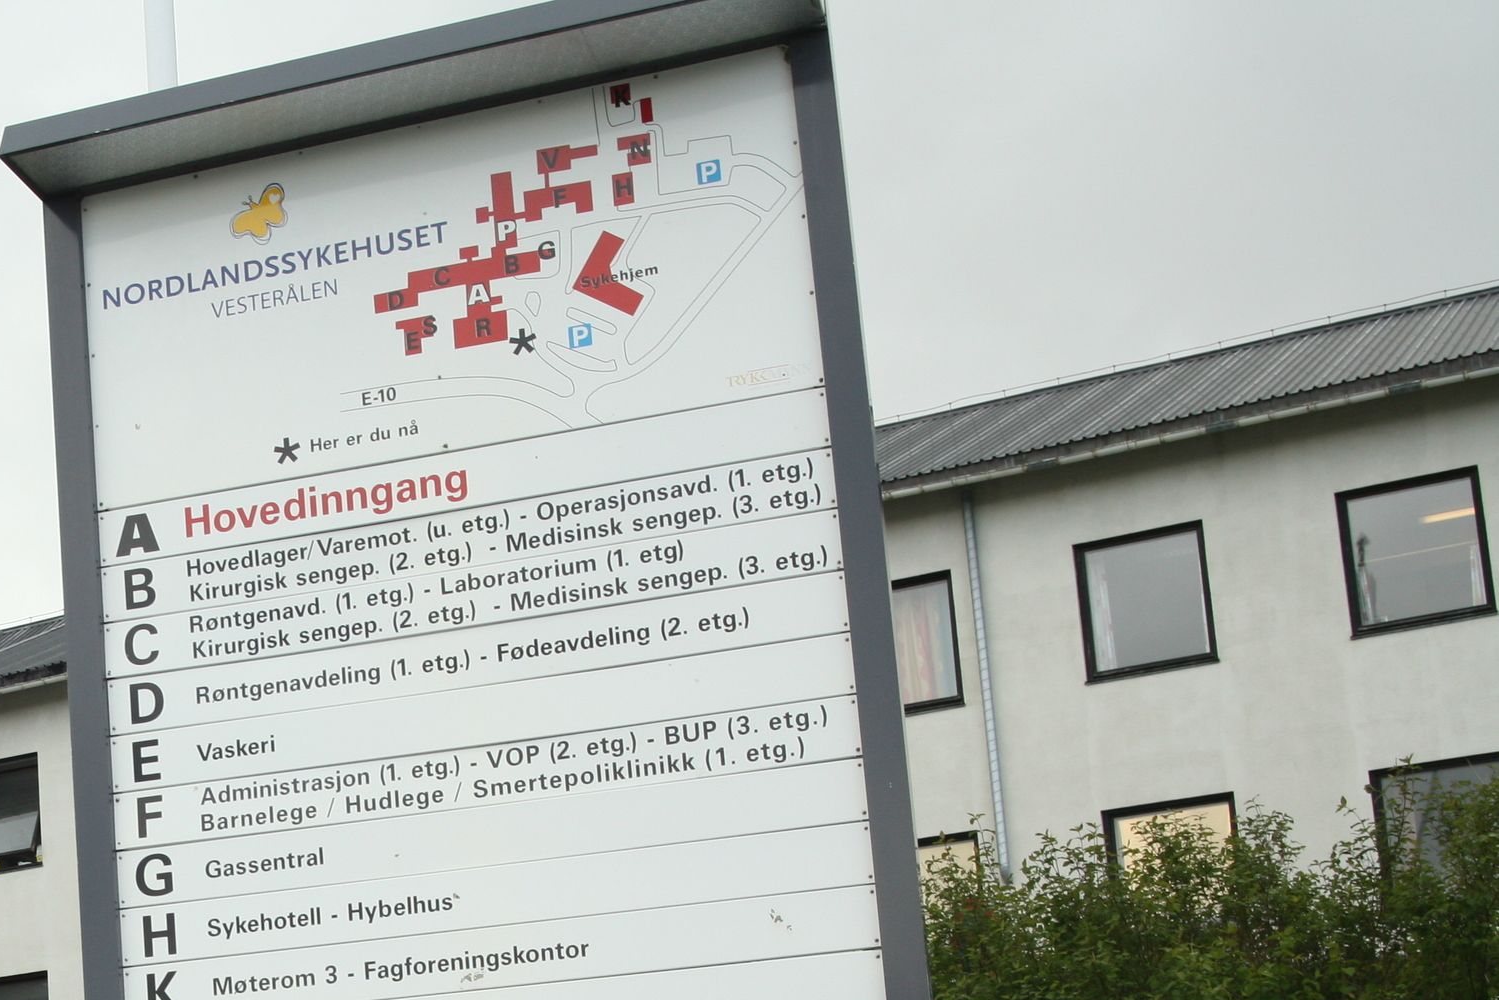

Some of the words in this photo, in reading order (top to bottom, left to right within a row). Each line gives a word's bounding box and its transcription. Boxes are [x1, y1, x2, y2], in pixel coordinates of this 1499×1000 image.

[615, 88, 631, 108] K
[541, 149, 559, 169] V
[630, 140, 651, 160] N
[616, 177, 633, 198] H
[701, 164, 717, 183] P
[553, 188, 567, 208] F
[498, 220, 516, 242] P
[102, 221, 448, 310] NORDLANDSSYKEHUSET
[504, 255, 519, 275] B
[538, 240, 556, 260] G
[434, 267, 450, 286] C
[581, 266, 658, 289] Sykehjem
[211, 278, 339, 318] VESTERÅLEN
[388, 291, 404, 310] D
[468, 284, 490, 305] A
[406, 331, 420, 351] E
[423, 315, 438, 336] S
[476, 318, 491, 338] R
[572, 326, 589, 347] P
[361, 387, 397, 406] E-10
[310, 437, 340, 453] Her
[346, 432, 363, 445] er
[369, 426, 392, 441] du
[398, 419, 420, 437] nå
[184, 470, 468, 538] Hovedinngang
[187, 527, 417, 577] Hovedlager/Varemot.
[427, 521, 452, 543] (u.
[462, 509, 509, 534] etg.)
[537, 474, 717, 522] Operasjonsavd.
[729, 469, 751, 492] (1.
[762, 457, 813, 483] etg.)
[116, 513, 160, 557] A
[190, 571, 287, 602] Kirurgisk
[296, 563, 379, 586] sengep.
[390, 552, 414, 575] (2.
[424, 541, 471, 567] etg.)
[506, 517, 623, 553] Medisinsk
[632, 506, 721, 532] sengep.
[733, 495, 759, 519] (3.
[770, 483, 821, 510] etg.)
[124, 568, 156, 610] B
[189, 597, 326, 633] Røntgenavd.
[336, 592, 356, 615] (1.
[367, 582, 413, 607] etg.)
[440, 558, 596, 595] Laboratorium
[607, 548, 629, 572] (1.
[640, 539, 683, 564] etg)
[193, 629, 291, 659] Kirurgisk
[299, 620, 382, 644] sengep.
[393, 610, 418, 633] (2.
[428, 600, 475, 625] etg.)
[510, 577, 628, 611] Medisinsk
[638, 567, 727, 592] sengep.
[739, 556, 764, 580] (3.
[776, 545, 827, 571] etg.)
[125, 623, 159, 665] C
[196, 666, 380, 704] Røntgenavdeling
[391, 658, 412, 681] (1.
[422, 649, 470, 674] etg.)
[497, 626, 650, 662] Fødeavdeling
[661, 617, 687, 641] (2.
[698, 606, 749, 632] etg.)
[129, 682, 164, 725] D
[132, 739, 161, 783] E
[196, 735, 275, 761] Vaskeri
[201, 770, 369, 805] Administrasjon
[380, 763, 401, 786] (1.
[412, 755, 459, 780] etg.)
[486, 745, 539, 768] VOP
[550, 741, 576, 764] (2.
[587, 731, 636, 757] etg.)
[665, 721, 716, 745] BUP
[728, 715, 758, 740] (3.
[769, 705, 827, 732] etg.)
[201, 806, 317, 832] Barnelege
[346, 790, 444, 814] Hudlege
[473, 752, 696, 798] Smertepoliklinikk
[706, 747, 735, 771] (1.
[747, 736, 804, 763] etg.)
[137, 795, 163, 839] F
[135, 853, 173, 897] G
[205, 847, 324, 878] Gassentral
[208, 907, 321, 940] Sykehotell
[348, 895, 453, 924] Hybelhus
[143, 912, 177, 958] H
[213, 973, 315, 996] Møterom
[325, 965, 337, 984] 3
[364, 943, 589, 982] Fagforeningskontor
